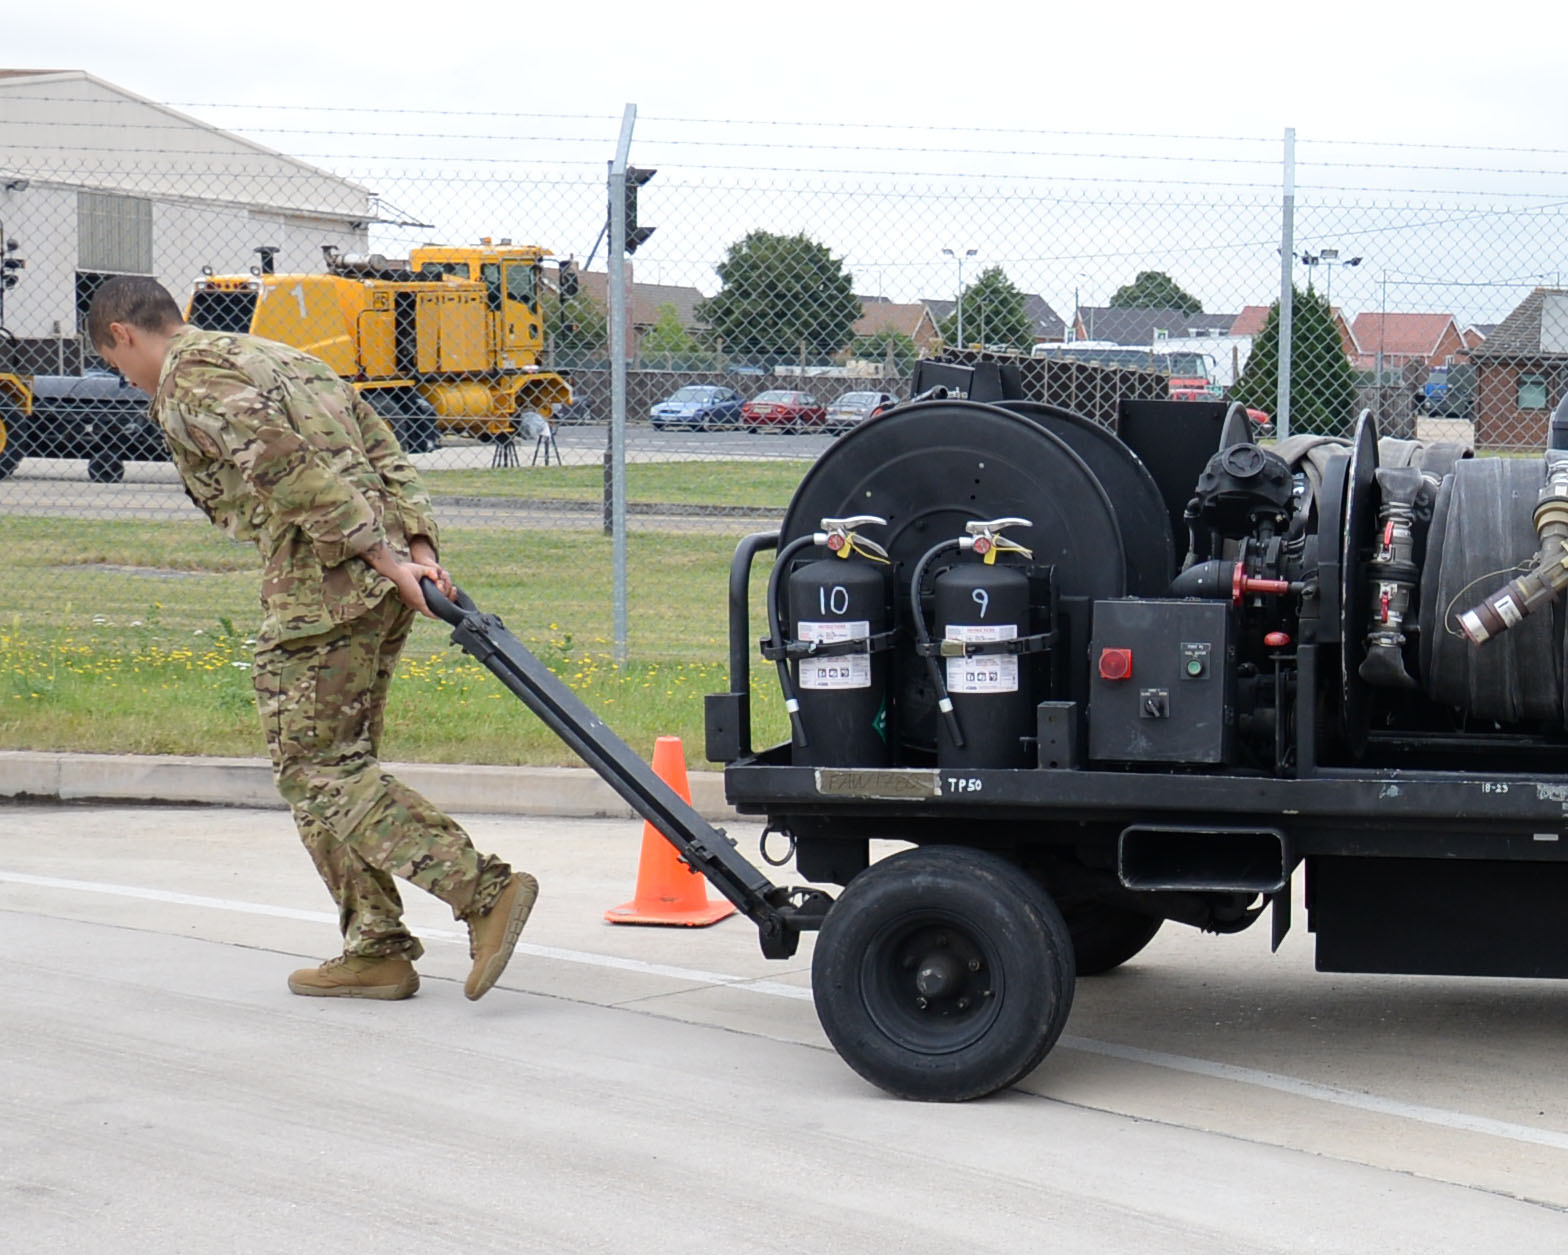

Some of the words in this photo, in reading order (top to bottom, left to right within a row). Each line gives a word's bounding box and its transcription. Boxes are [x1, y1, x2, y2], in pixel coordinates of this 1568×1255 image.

[290, 283, 308, 319] 1
[820, 586, 848, 615] 10
[972, 588, 988, 618] 9
[948, 778, 982, 792] TP50
